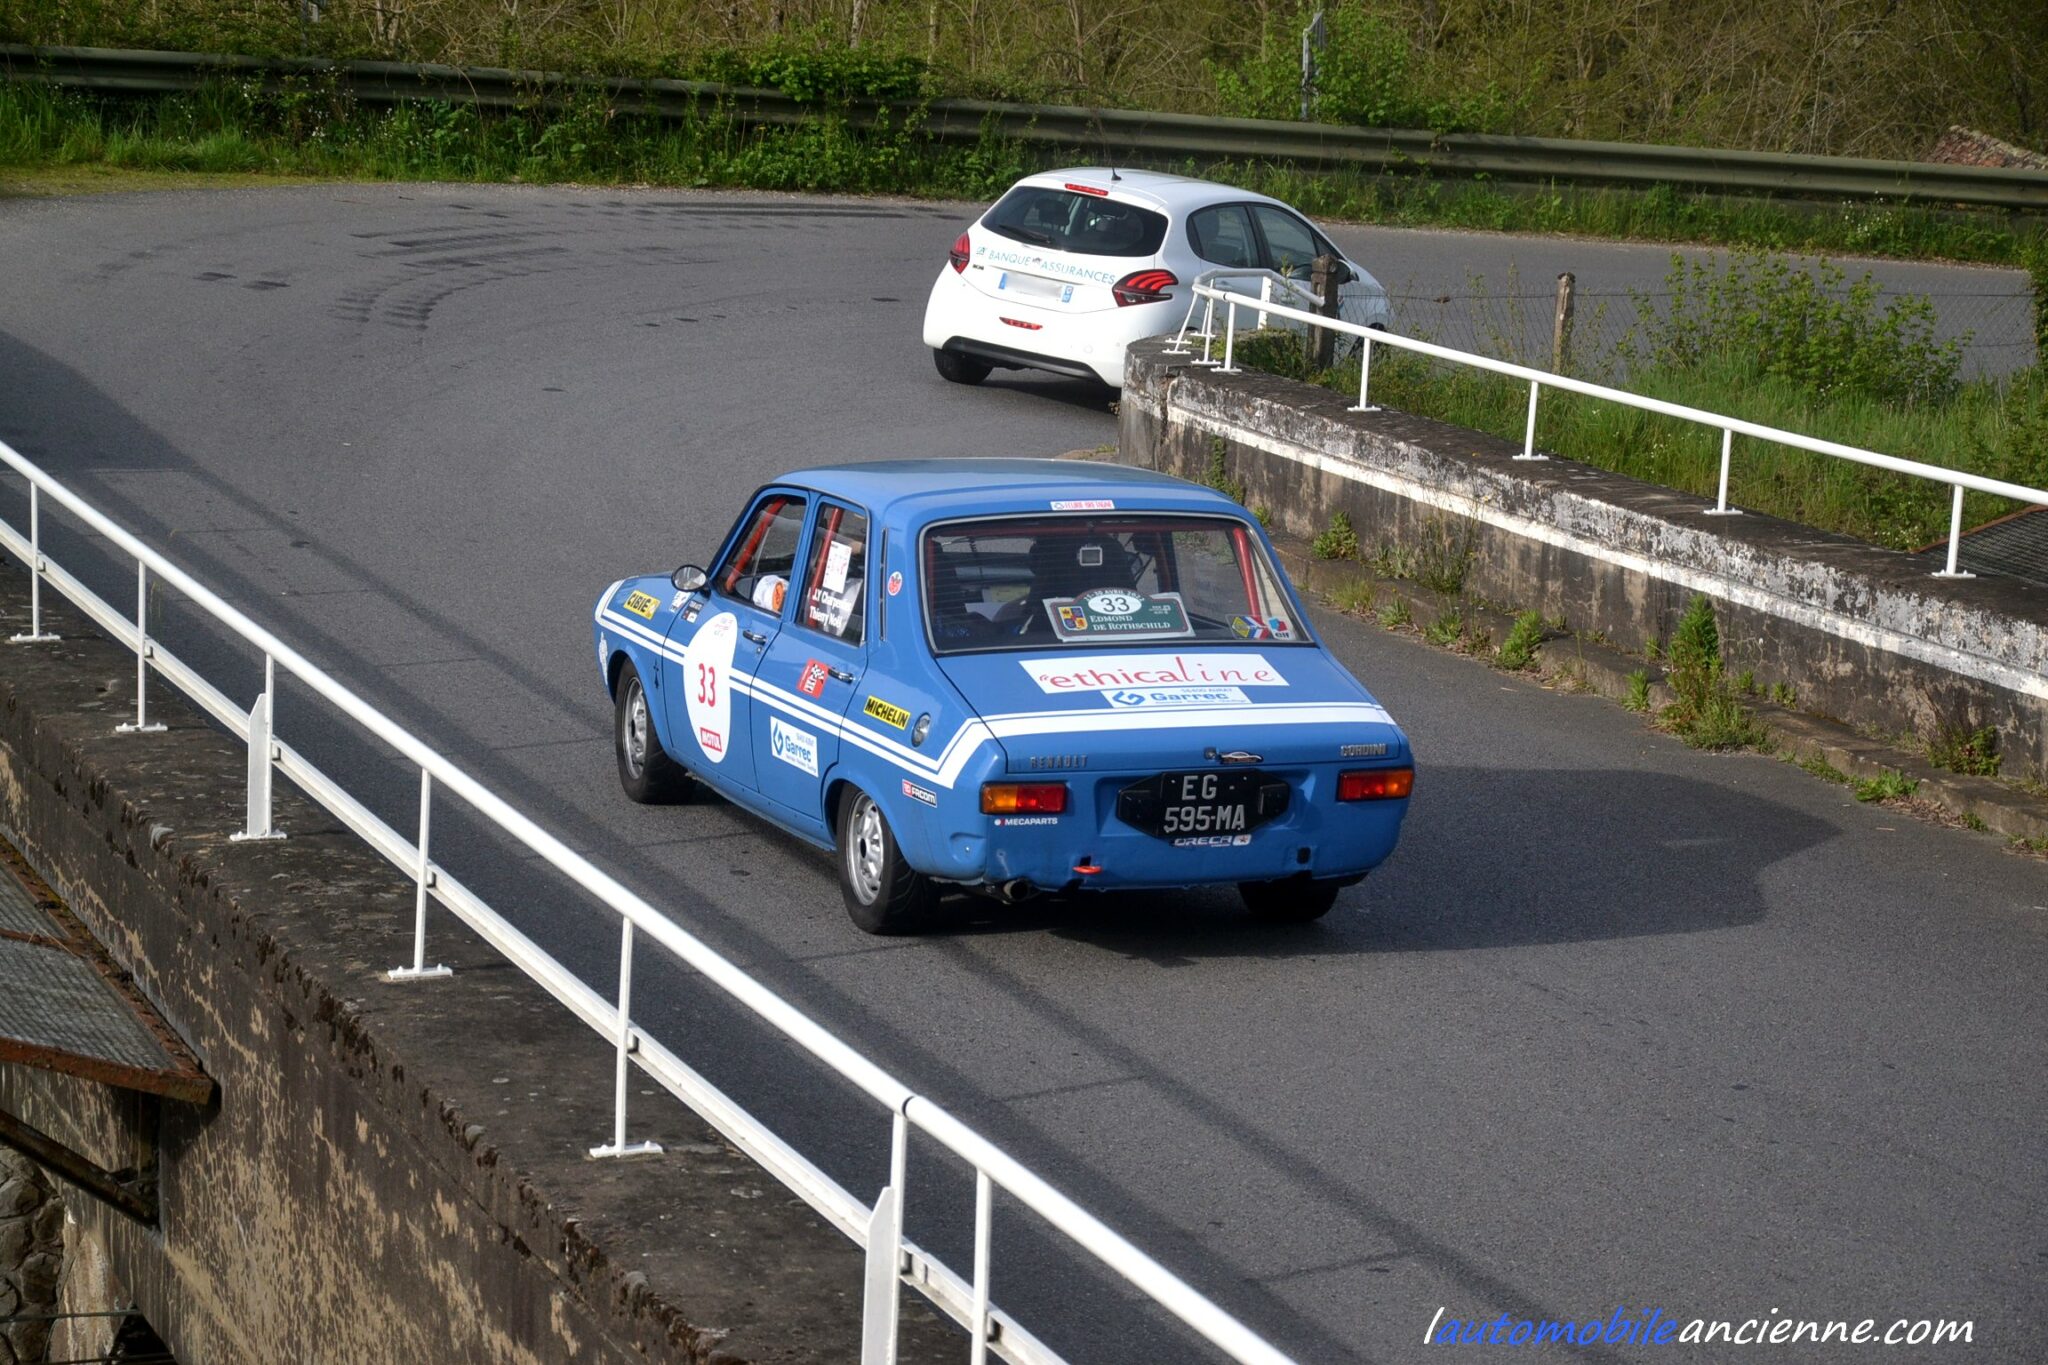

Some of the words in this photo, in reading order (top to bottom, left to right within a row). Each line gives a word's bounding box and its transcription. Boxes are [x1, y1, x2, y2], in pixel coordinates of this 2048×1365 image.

[988, 249, 1031, 266] BANQUE
[1040, 260, 1116, 285] ASSURANCES
[1100, 597, 1130, 612] 33
[1090, 615, 1133, 623] EDMOND
[1108, 622, 1171, 631] ROTHSCHILD
[1275, 631, 1290, 639] elf
[698, 663, 716, 707] 33
[1150, 692, 1229, 702] Garrec
[864, 698, 909, 727] MICHELIN
[701, 729, 721, 749] MOTUL
[784, 735, 812, 763] Garrec
[1340, 743, 1387, 757] GORDINI
[1030, 754, 1088, 769] RENAULT
[1182, 774, 1218, 800] EG
[911, 785, 937, 806] FACOM
[1004, 817, 1058, 826] MECAPARTS
[1163, 805, 1246, 833] 595-MA
[1174, 835, 1233, 847] ORECA
